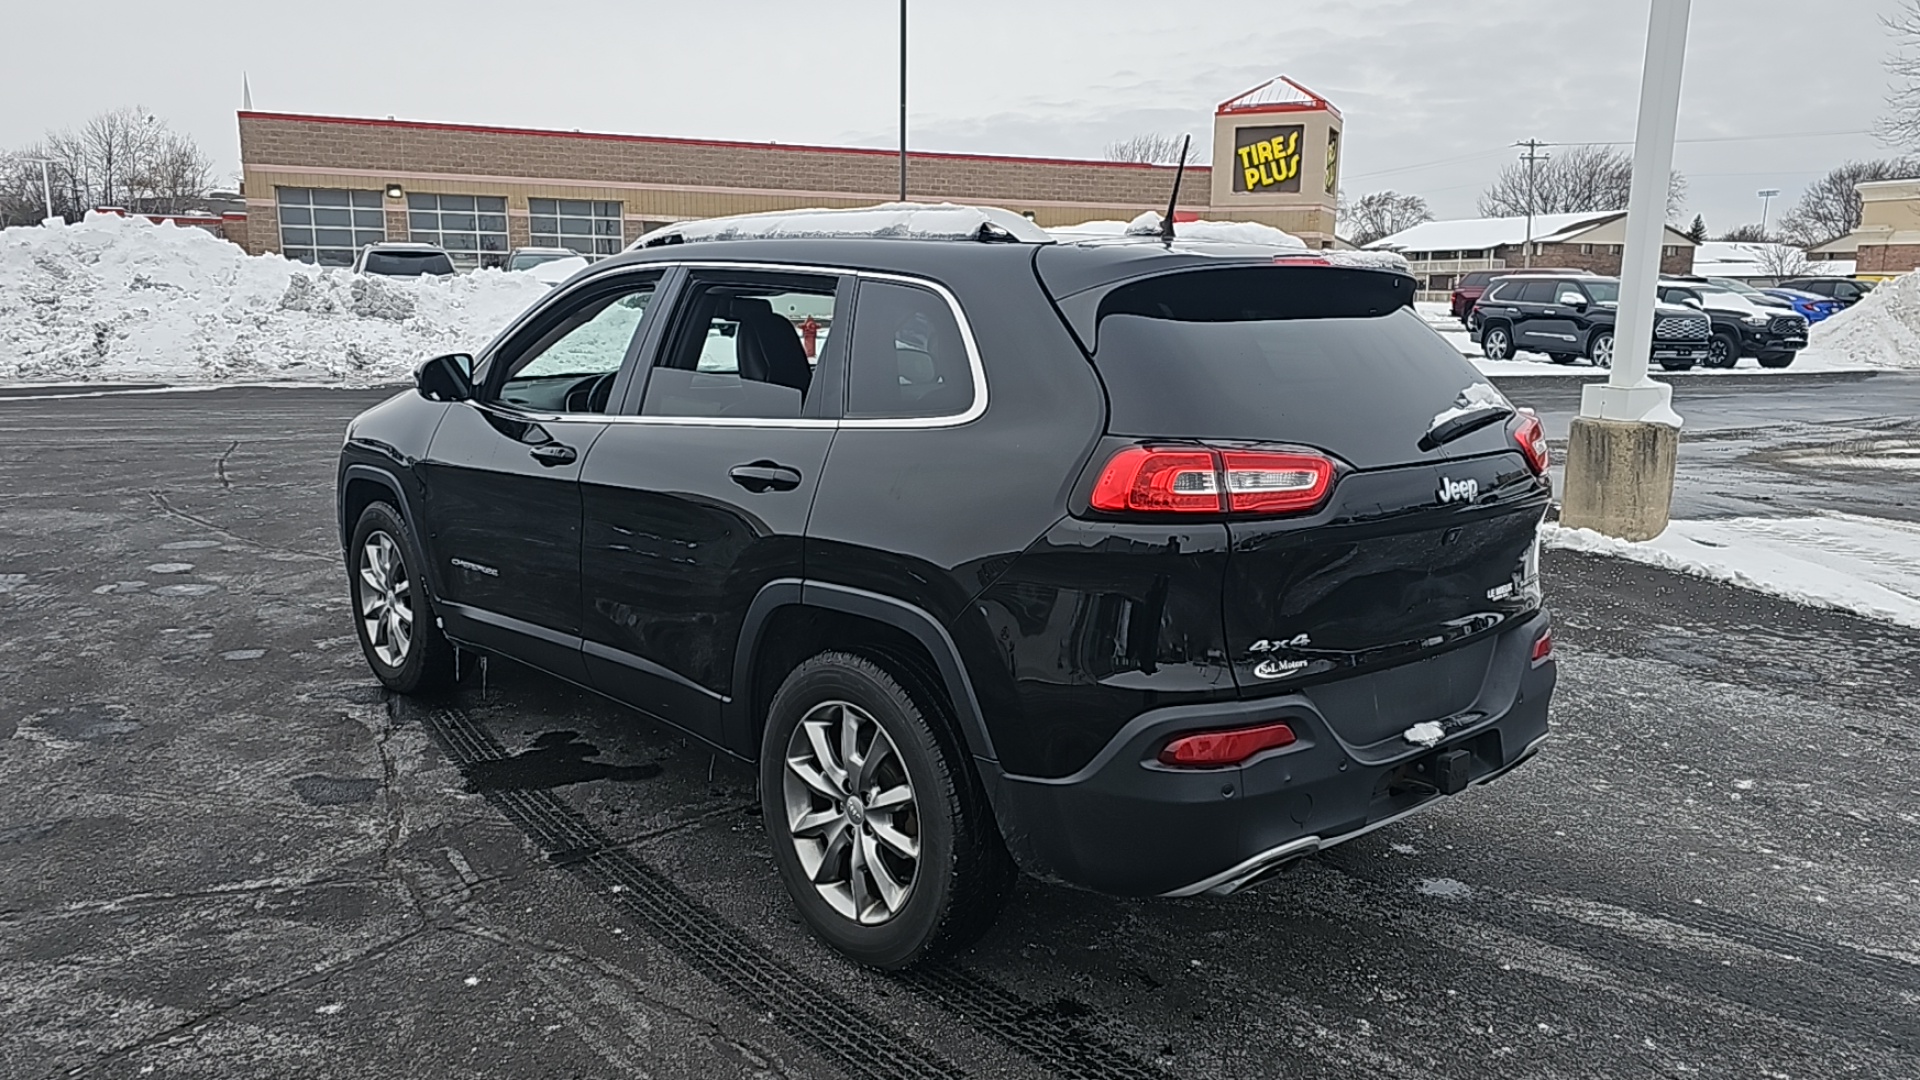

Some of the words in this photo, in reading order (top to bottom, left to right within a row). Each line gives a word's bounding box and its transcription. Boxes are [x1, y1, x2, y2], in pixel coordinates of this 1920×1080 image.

[1237, 131, 1299, 169] TIRES
[1244, 153, 1300, 190] PLUS
[1439, 476, 1478, 503] Jeep
[1249, 633, 1311, 652] 4x4
[1278, 660, 1308, 671] Motors
